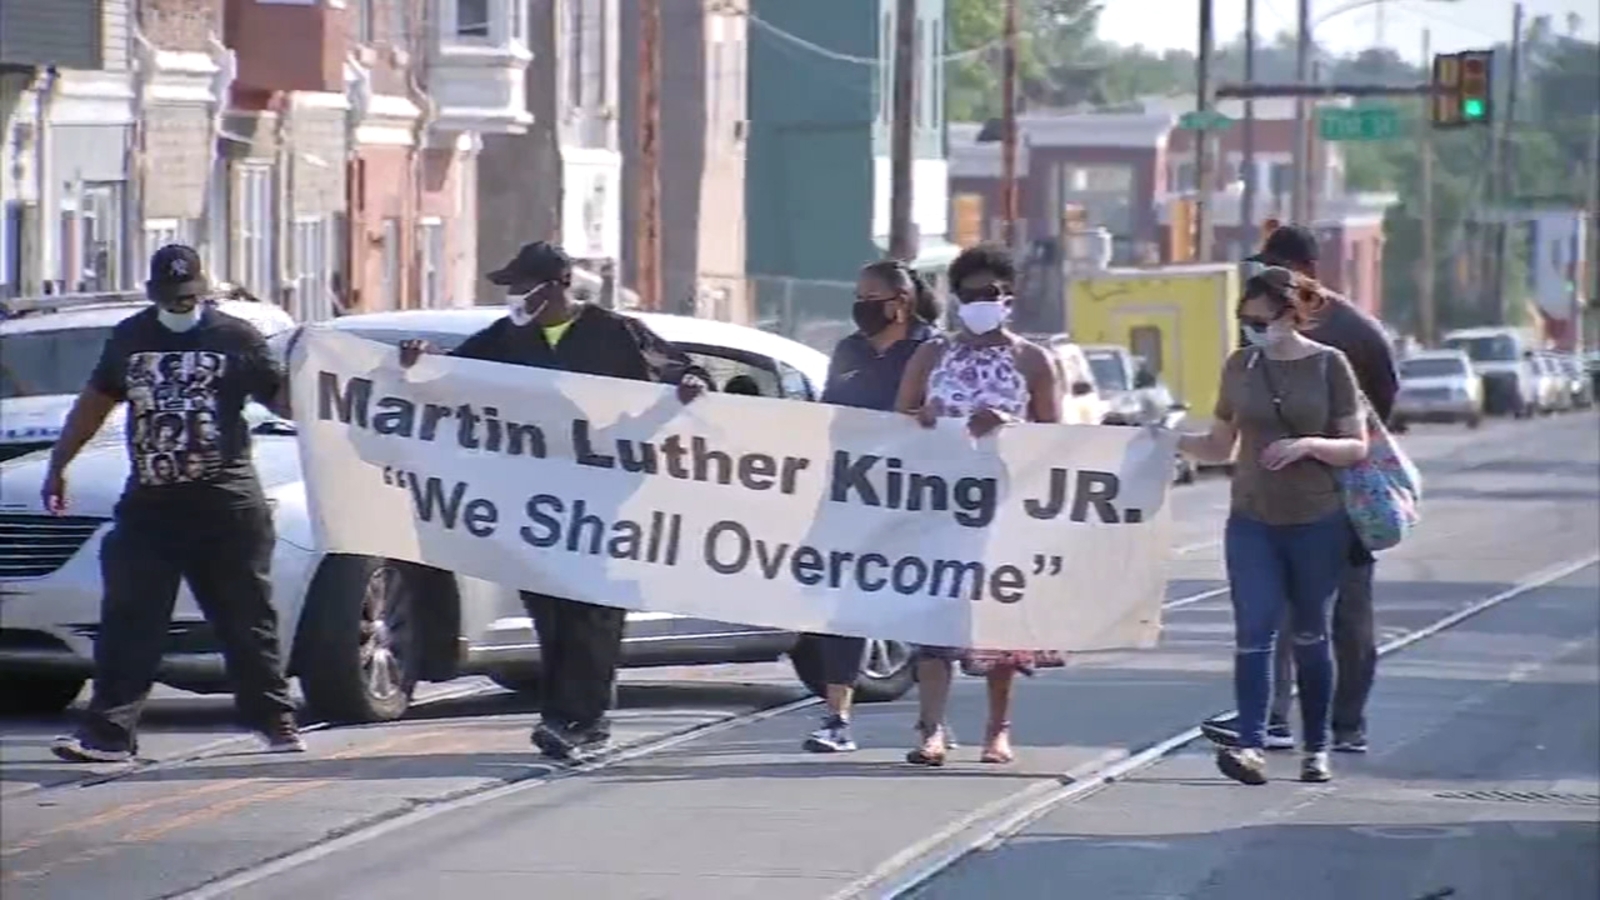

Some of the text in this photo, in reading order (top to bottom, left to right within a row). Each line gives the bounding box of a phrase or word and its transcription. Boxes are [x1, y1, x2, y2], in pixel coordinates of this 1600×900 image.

[318, 370, 1142, 528] Martin Luther King JR.
[383, 465, 1063, 604] “We Shall Overcome”
